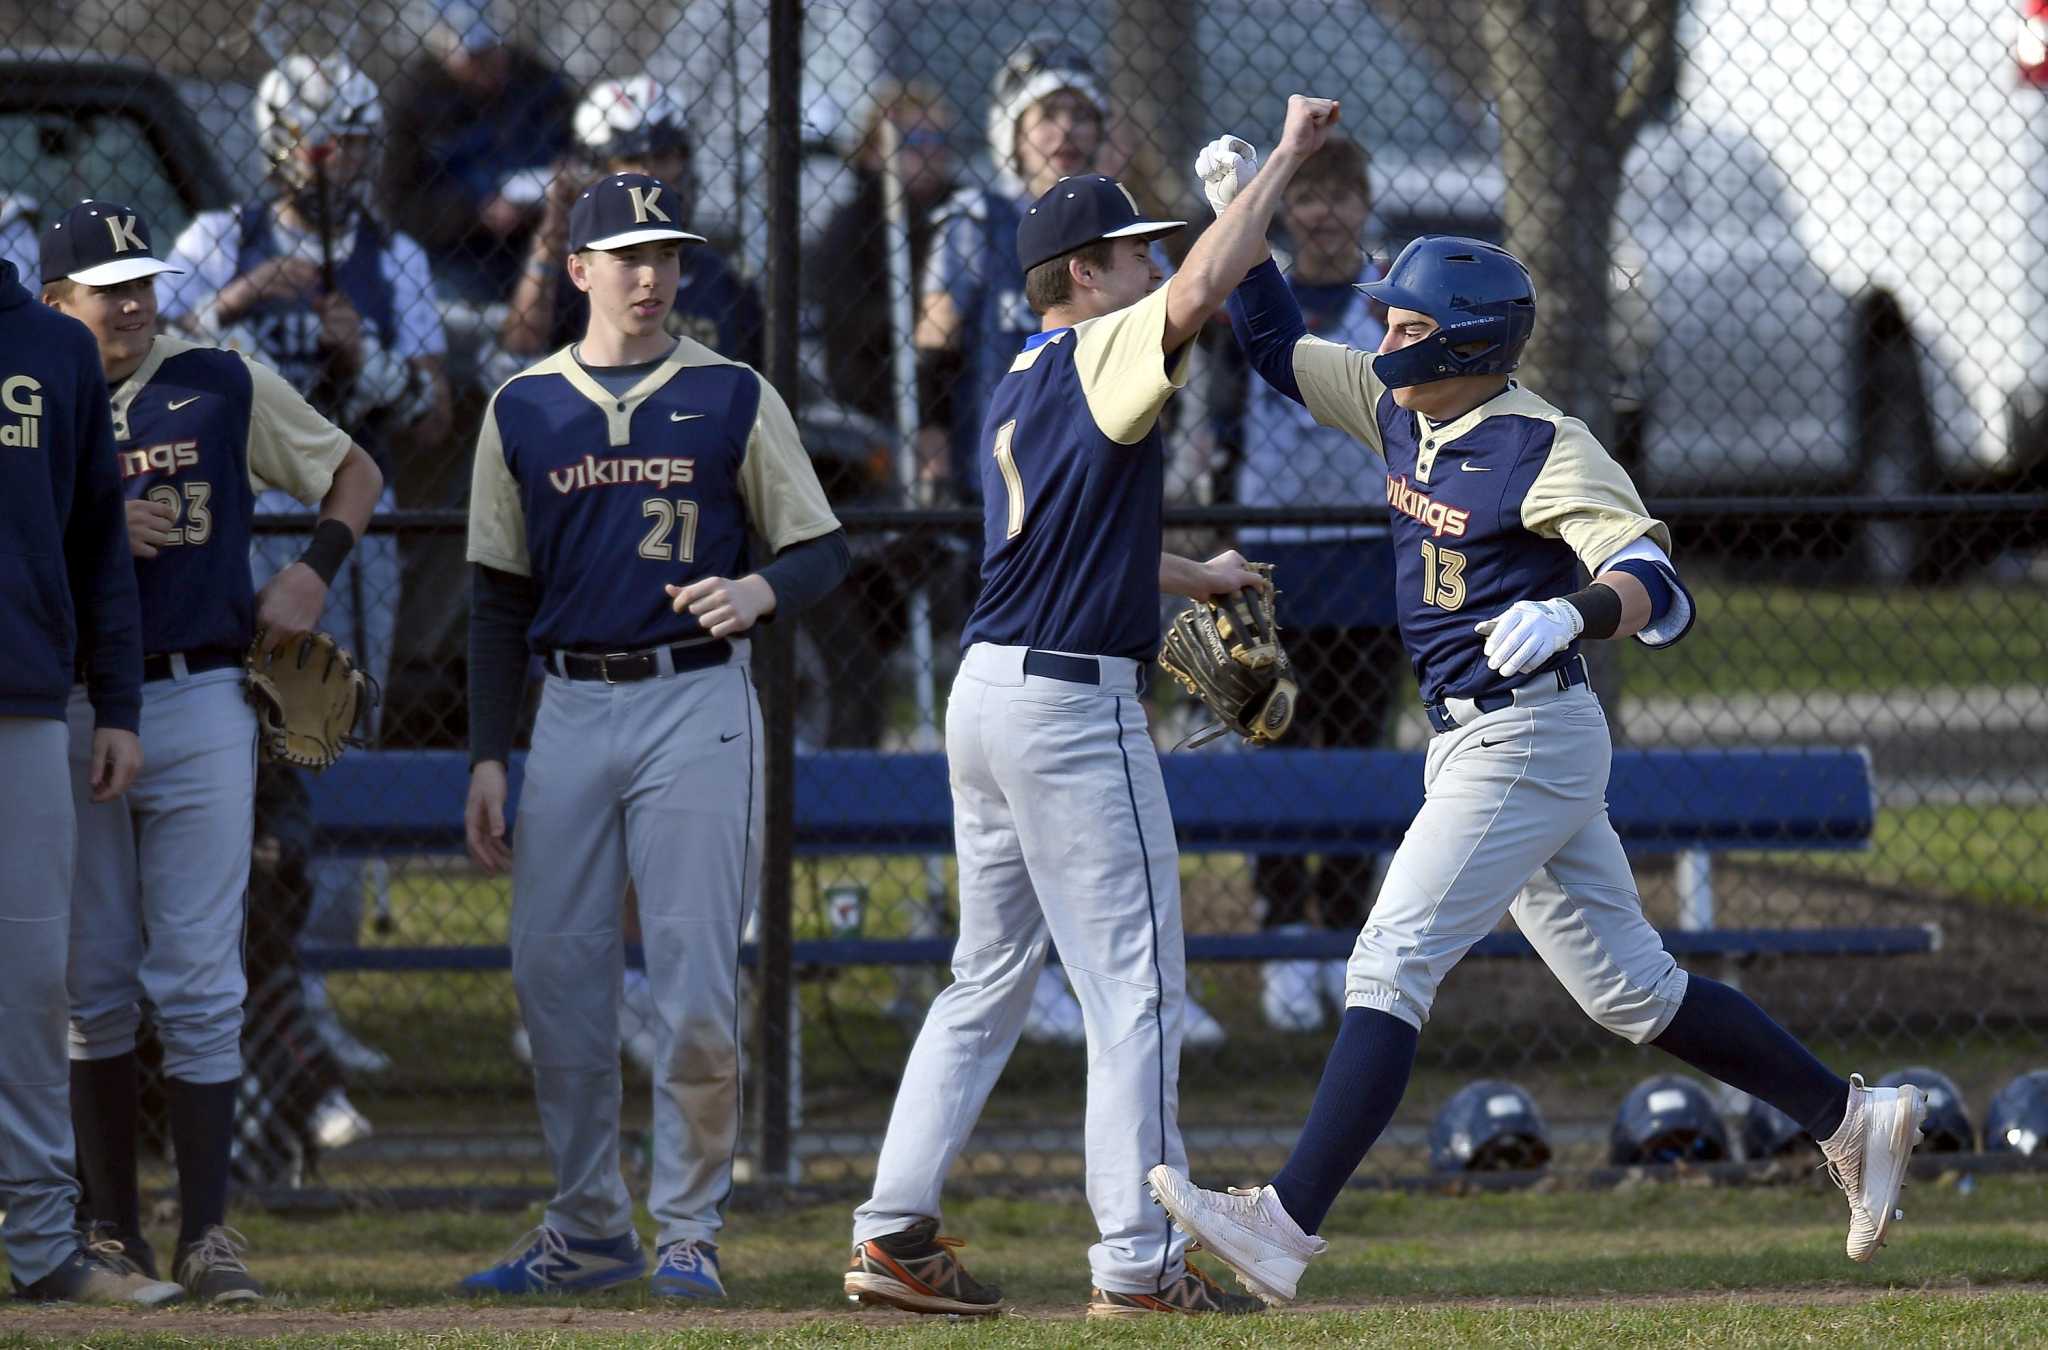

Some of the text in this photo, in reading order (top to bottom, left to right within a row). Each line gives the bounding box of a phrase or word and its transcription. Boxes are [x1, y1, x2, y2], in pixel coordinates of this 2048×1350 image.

[626, 186, 672, 224] K
[103, 215, 149, 253] K
[1, 374, 43, 416] G
[121, 439, 200, 479] ngs
[992, 418, 1025, 541] 1
[147, 481, 213, 546] 23
[638, 497, 699, 564] 21
[1420, 538, 1467, 612] 13
